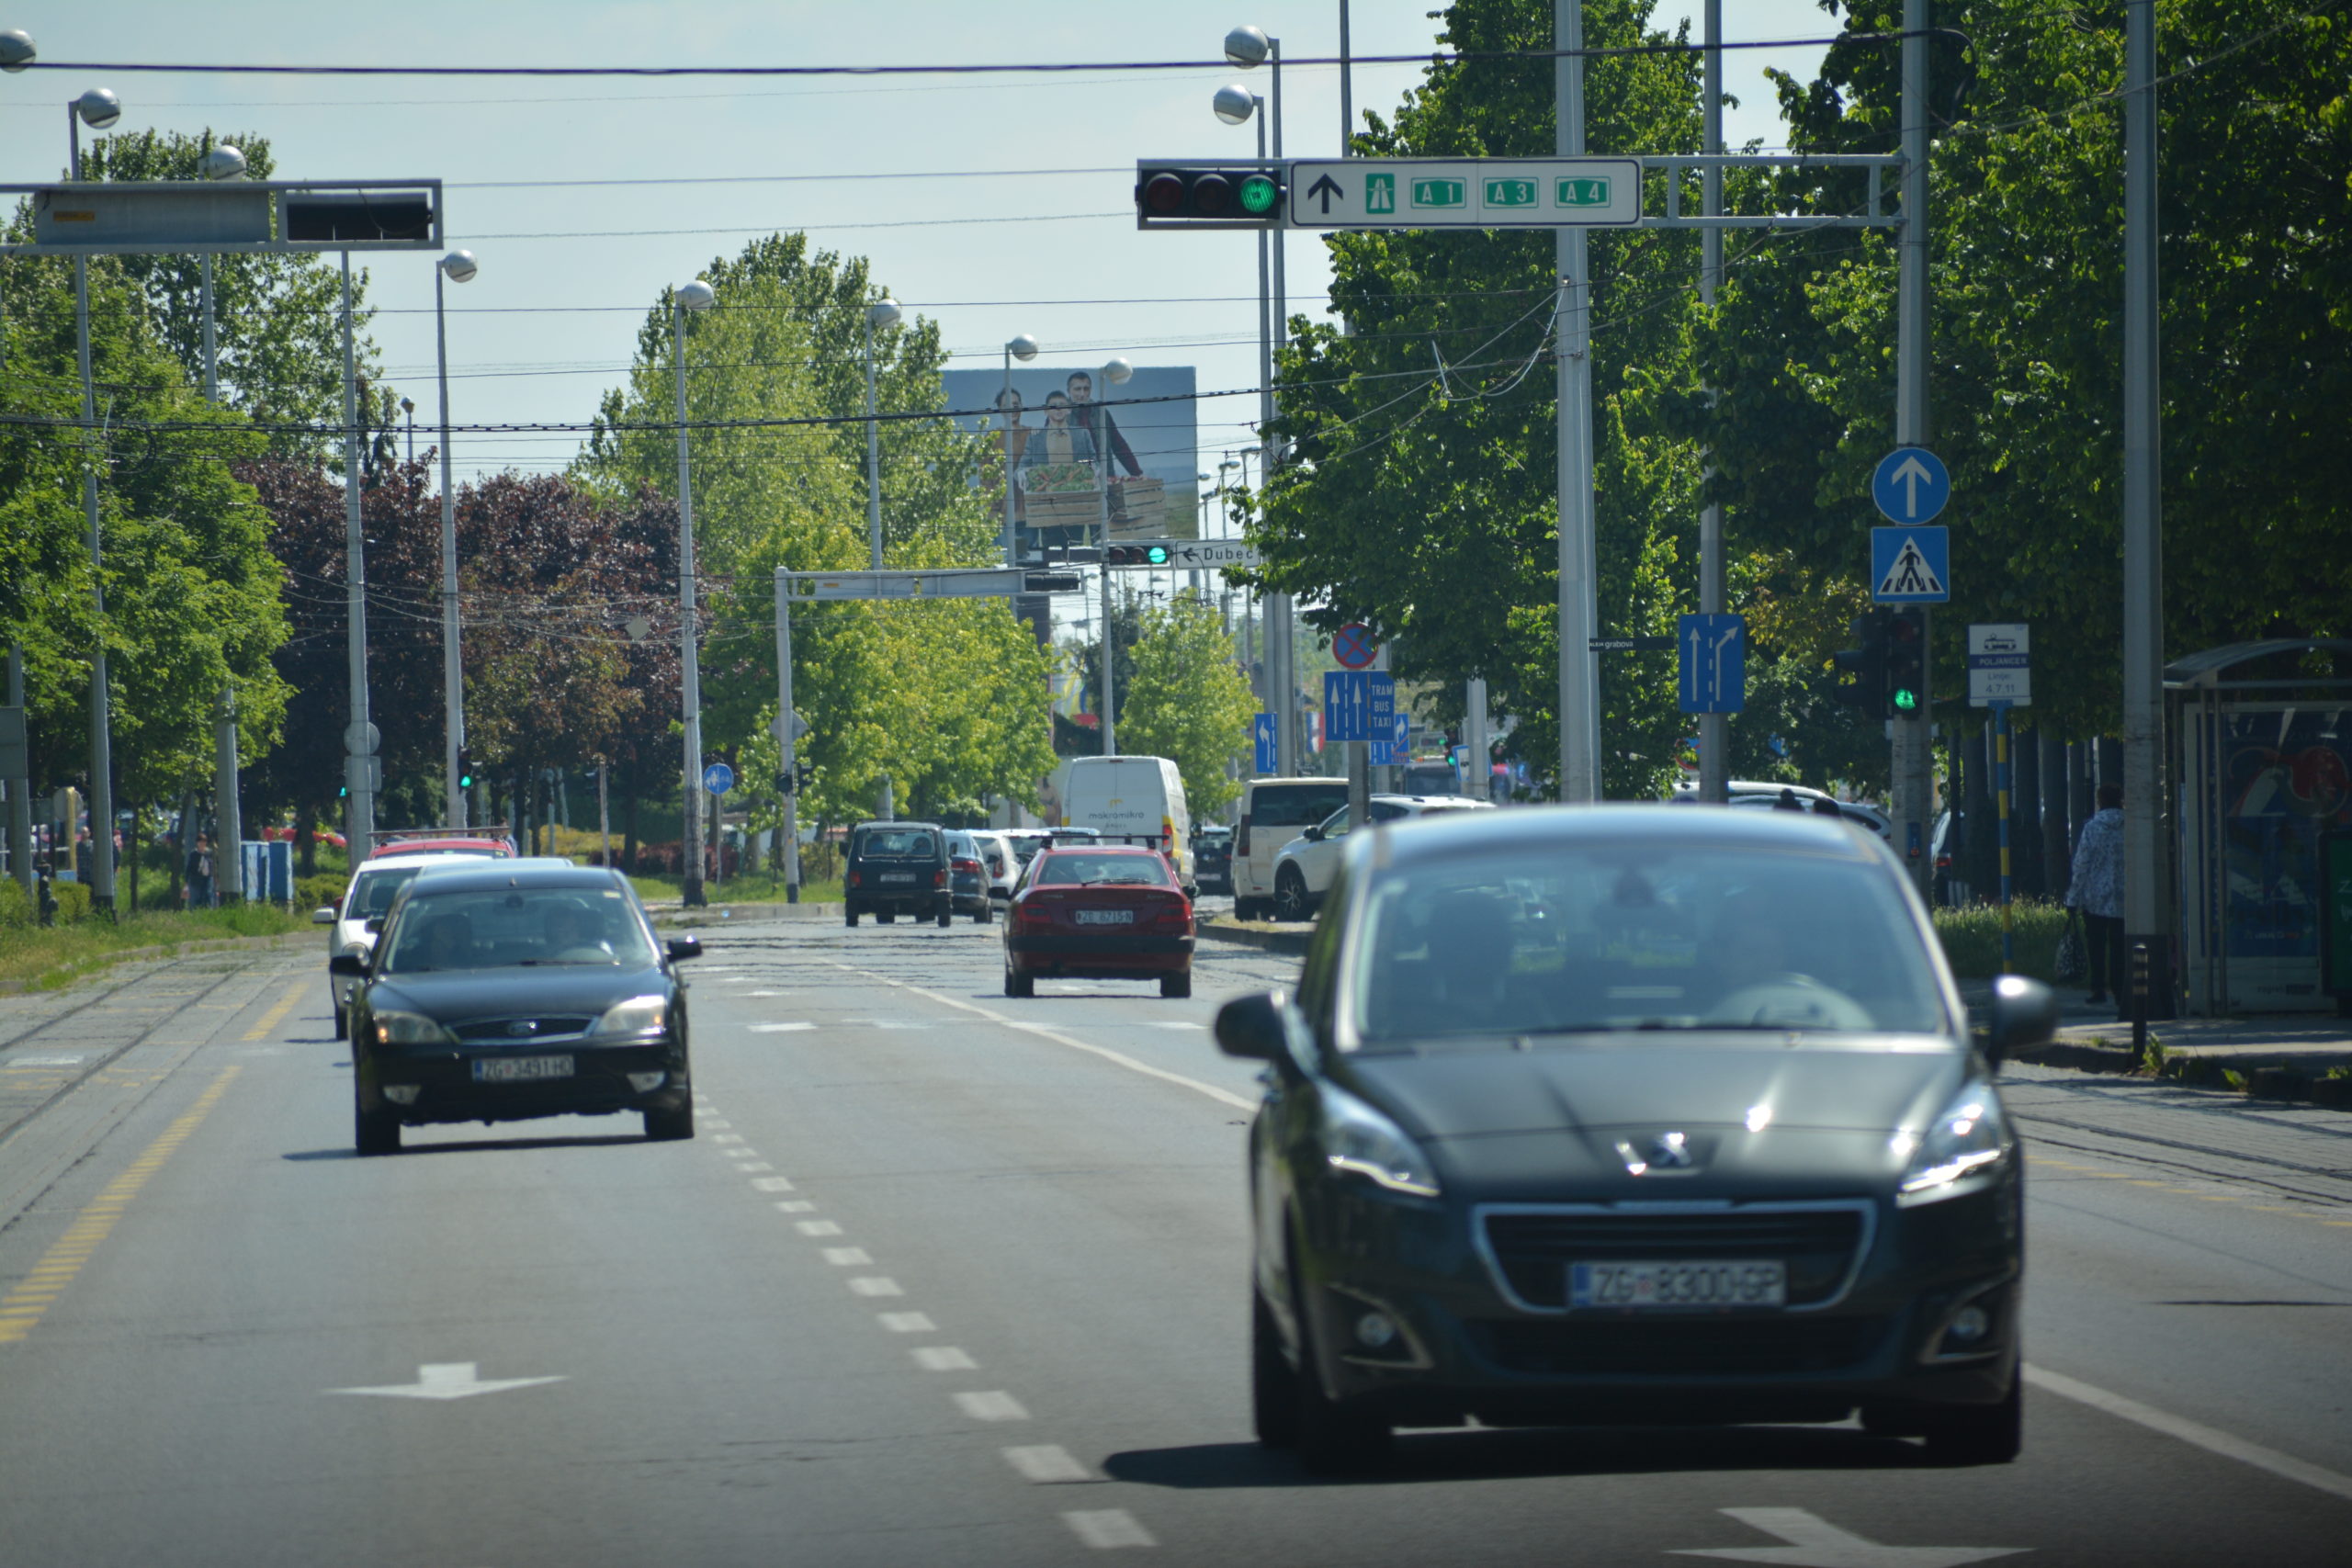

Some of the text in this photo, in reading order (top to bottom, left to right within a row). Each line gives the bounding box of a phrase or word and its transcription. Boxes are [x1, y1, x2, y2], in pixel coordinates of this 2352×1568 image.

[1204, 547, 1253, 560] Dubec
[1604, 640, 1634, 649] grabova
[1371, 684, 1393, 696] TRAM
[1374, 701, 1390, 713] BUS
[1373, 716, 1392, 728] TAXI
[1088, 811, 1145, 819] makromikro
[1596, 1267, 1634, 1302] ZG
